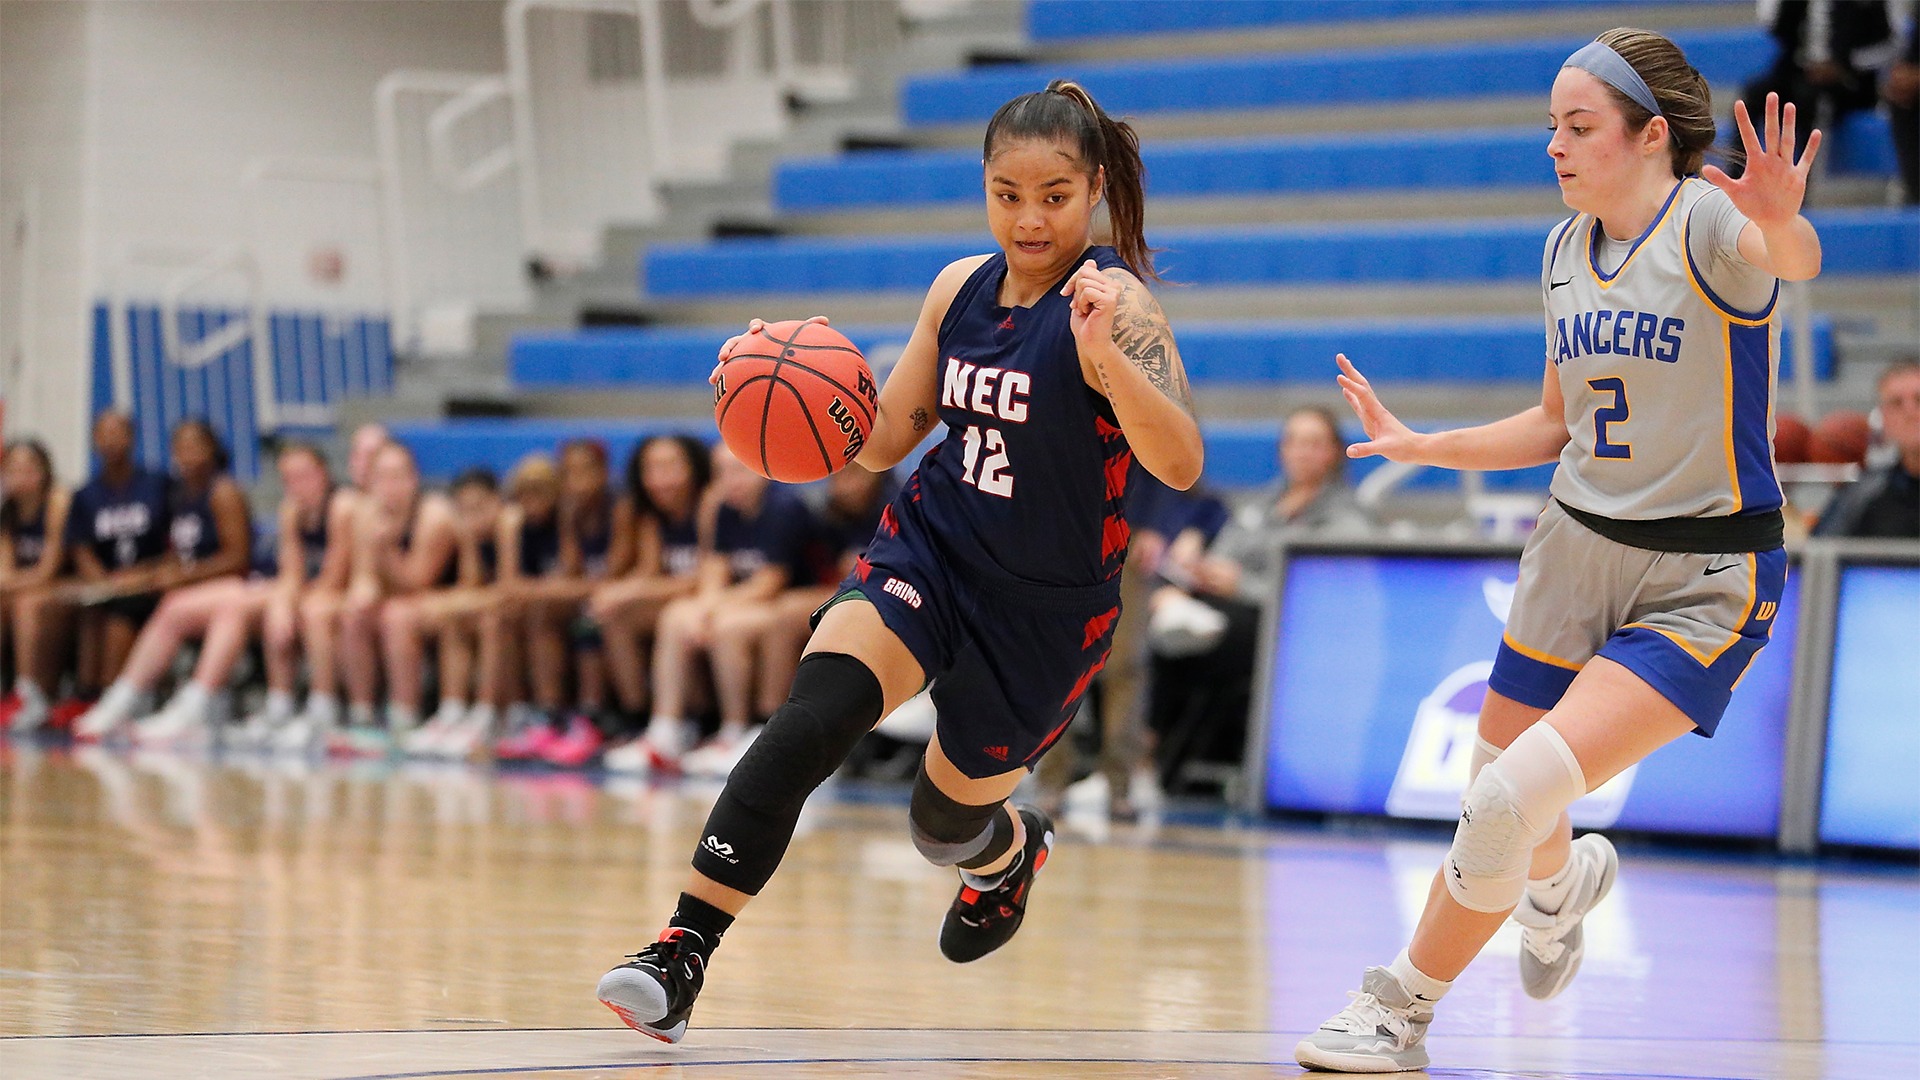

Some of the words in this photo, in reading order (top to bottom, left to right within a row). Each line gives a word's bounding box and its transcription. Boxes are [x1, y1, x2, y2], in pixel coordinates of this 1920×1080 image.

[1554, 309, 1685, 365] ANCERS
[941, 356, 1031, 423] NEC
[1586, 376, 1632, 461] 2
[962, 424, 1015, 499] 12
[882, 577, 922, 609] GRIMS
